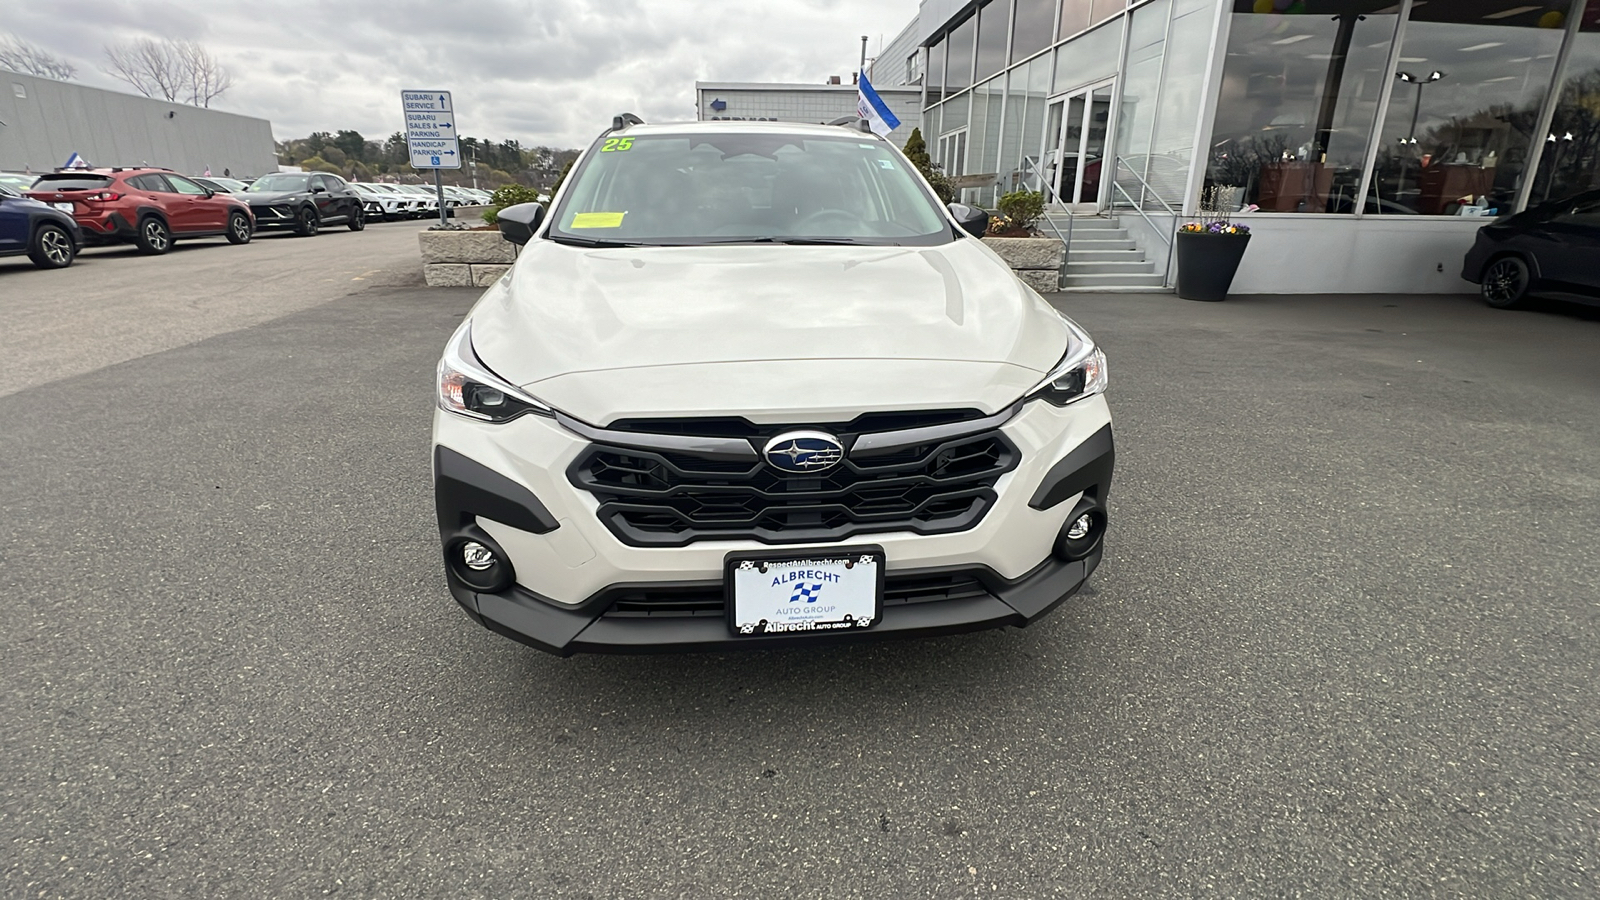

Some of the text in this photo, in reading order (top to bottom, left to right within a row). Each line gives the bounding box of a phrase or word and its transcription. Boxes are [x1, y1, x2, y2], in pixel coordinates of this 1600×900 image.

[601, 137, 636, 152] 25
[771, 570, 841, 587] ALBRECHT
[776, 606, 836, 615] AUTO GROUP
[763, 620, 816, 633] Albrecht
